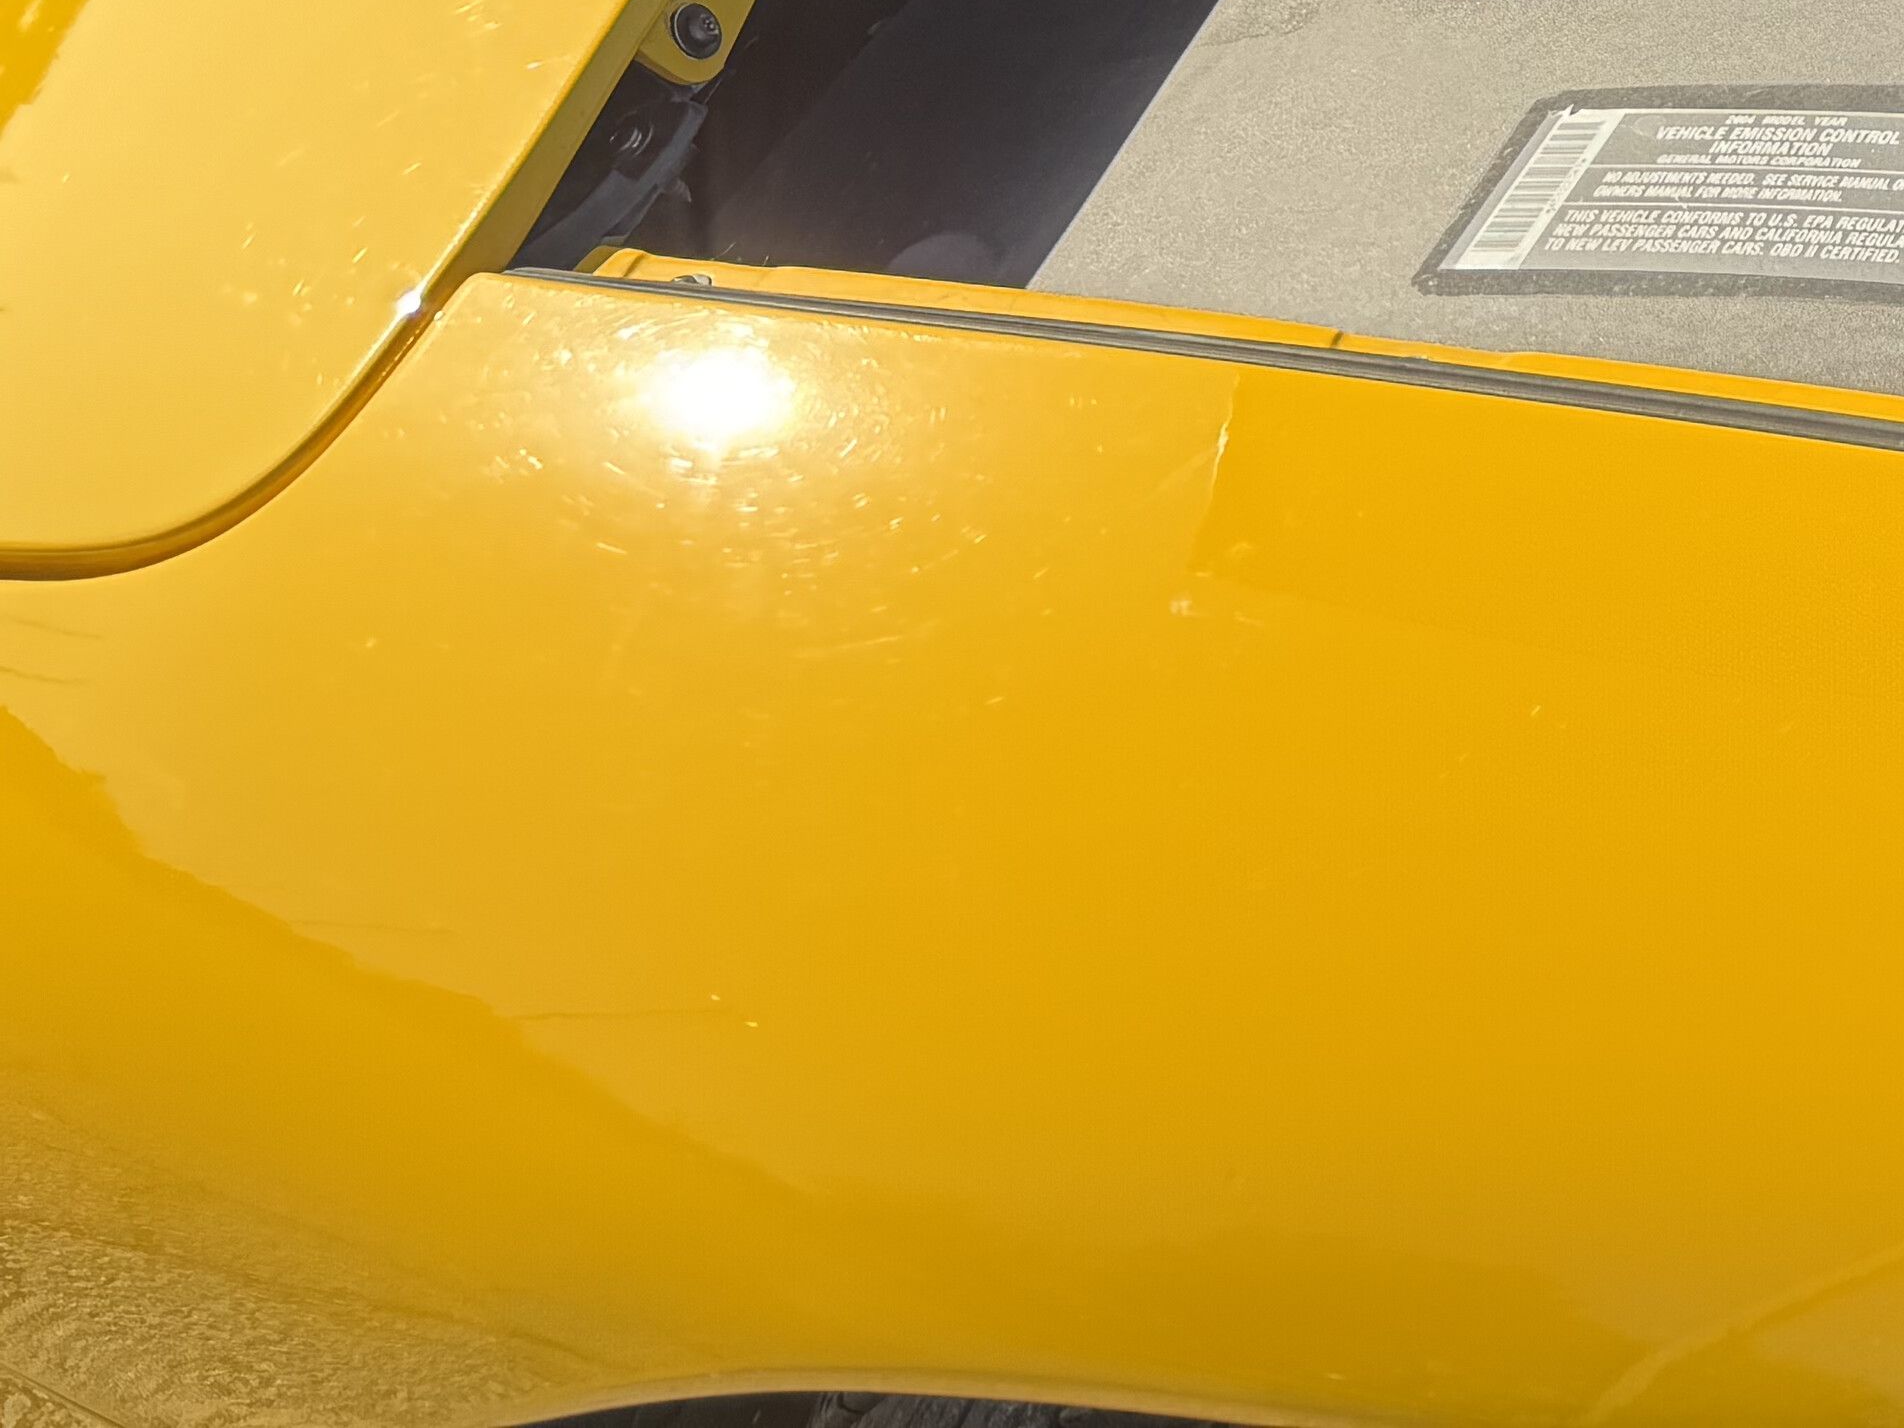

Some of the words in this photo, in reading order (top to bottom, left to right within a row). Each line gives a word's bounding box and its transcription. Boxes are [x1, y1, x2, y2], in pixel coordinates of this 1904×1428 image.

[1762, 115, 1806, 126] MODEL
[1814, 116, 1848, 126] YEAR
[1656, 126, 1726, 141] VEHICLE
[1729, 127, 1813, 142] EMISSION
[1817, 129, 1901, 145] CONTROL
[1709, 141, 1833, 156] INFORMATION
[1656, 154, 1713, 165] GENERAL
[1716, 155, 1770, 166] MOTORS
[1771, 157, 1861, 168] CORPORATION
[1602, 172, 1622, 183] NO
[1623, 172, 1707, 184] ADJUSTMENTS
[1709, 173, 1756, 185] NEEDED.
[1762, 174, 1789, 185] SEE
[1789, 174, 1837, 187] SERVICE
[1839, 176, 1891, 190] MANUAL
[1644, 186, 1693, 198] MANUAL
[1695, 187, 1718, 199] FOR
[1719, 187, 1757, 200] MORE
[1759, 188, 1843, 202] INFORMATION.
[1564, 209, 1599, 222] THIS
[1599, 210, 1659, 224] VEHICLE
[1661, 211, 1743, 226] CONFORMS
[1747, 212, 1768, 225] TO
[1769, 213, 1799, 227] U.S.
[1803, 214, 1832, 228] EPA
[1553, 223, 1592, 237] NEW
[1591, 224, 1678, 239] PASSENGER
[1678, 225, 1720, 240] CARS
[1721, 226, 1751, 241] AND
[1752, 227, 1841, 244] CALIFORNIA
[1545, 237, 1564, 250] TO
[1566, 238, 1603, 252] NEW
[1603, 240, 1632, 253] LEV
[1632, 240, 1720, 255] PASSENGER
[1722, 242, 1764, 256] CARS.
[1770, 244, 1802, 257] OBD
[1804, 245, 1818, 258] II
[1820, 247, 1901, 264] CERTIFIED.
